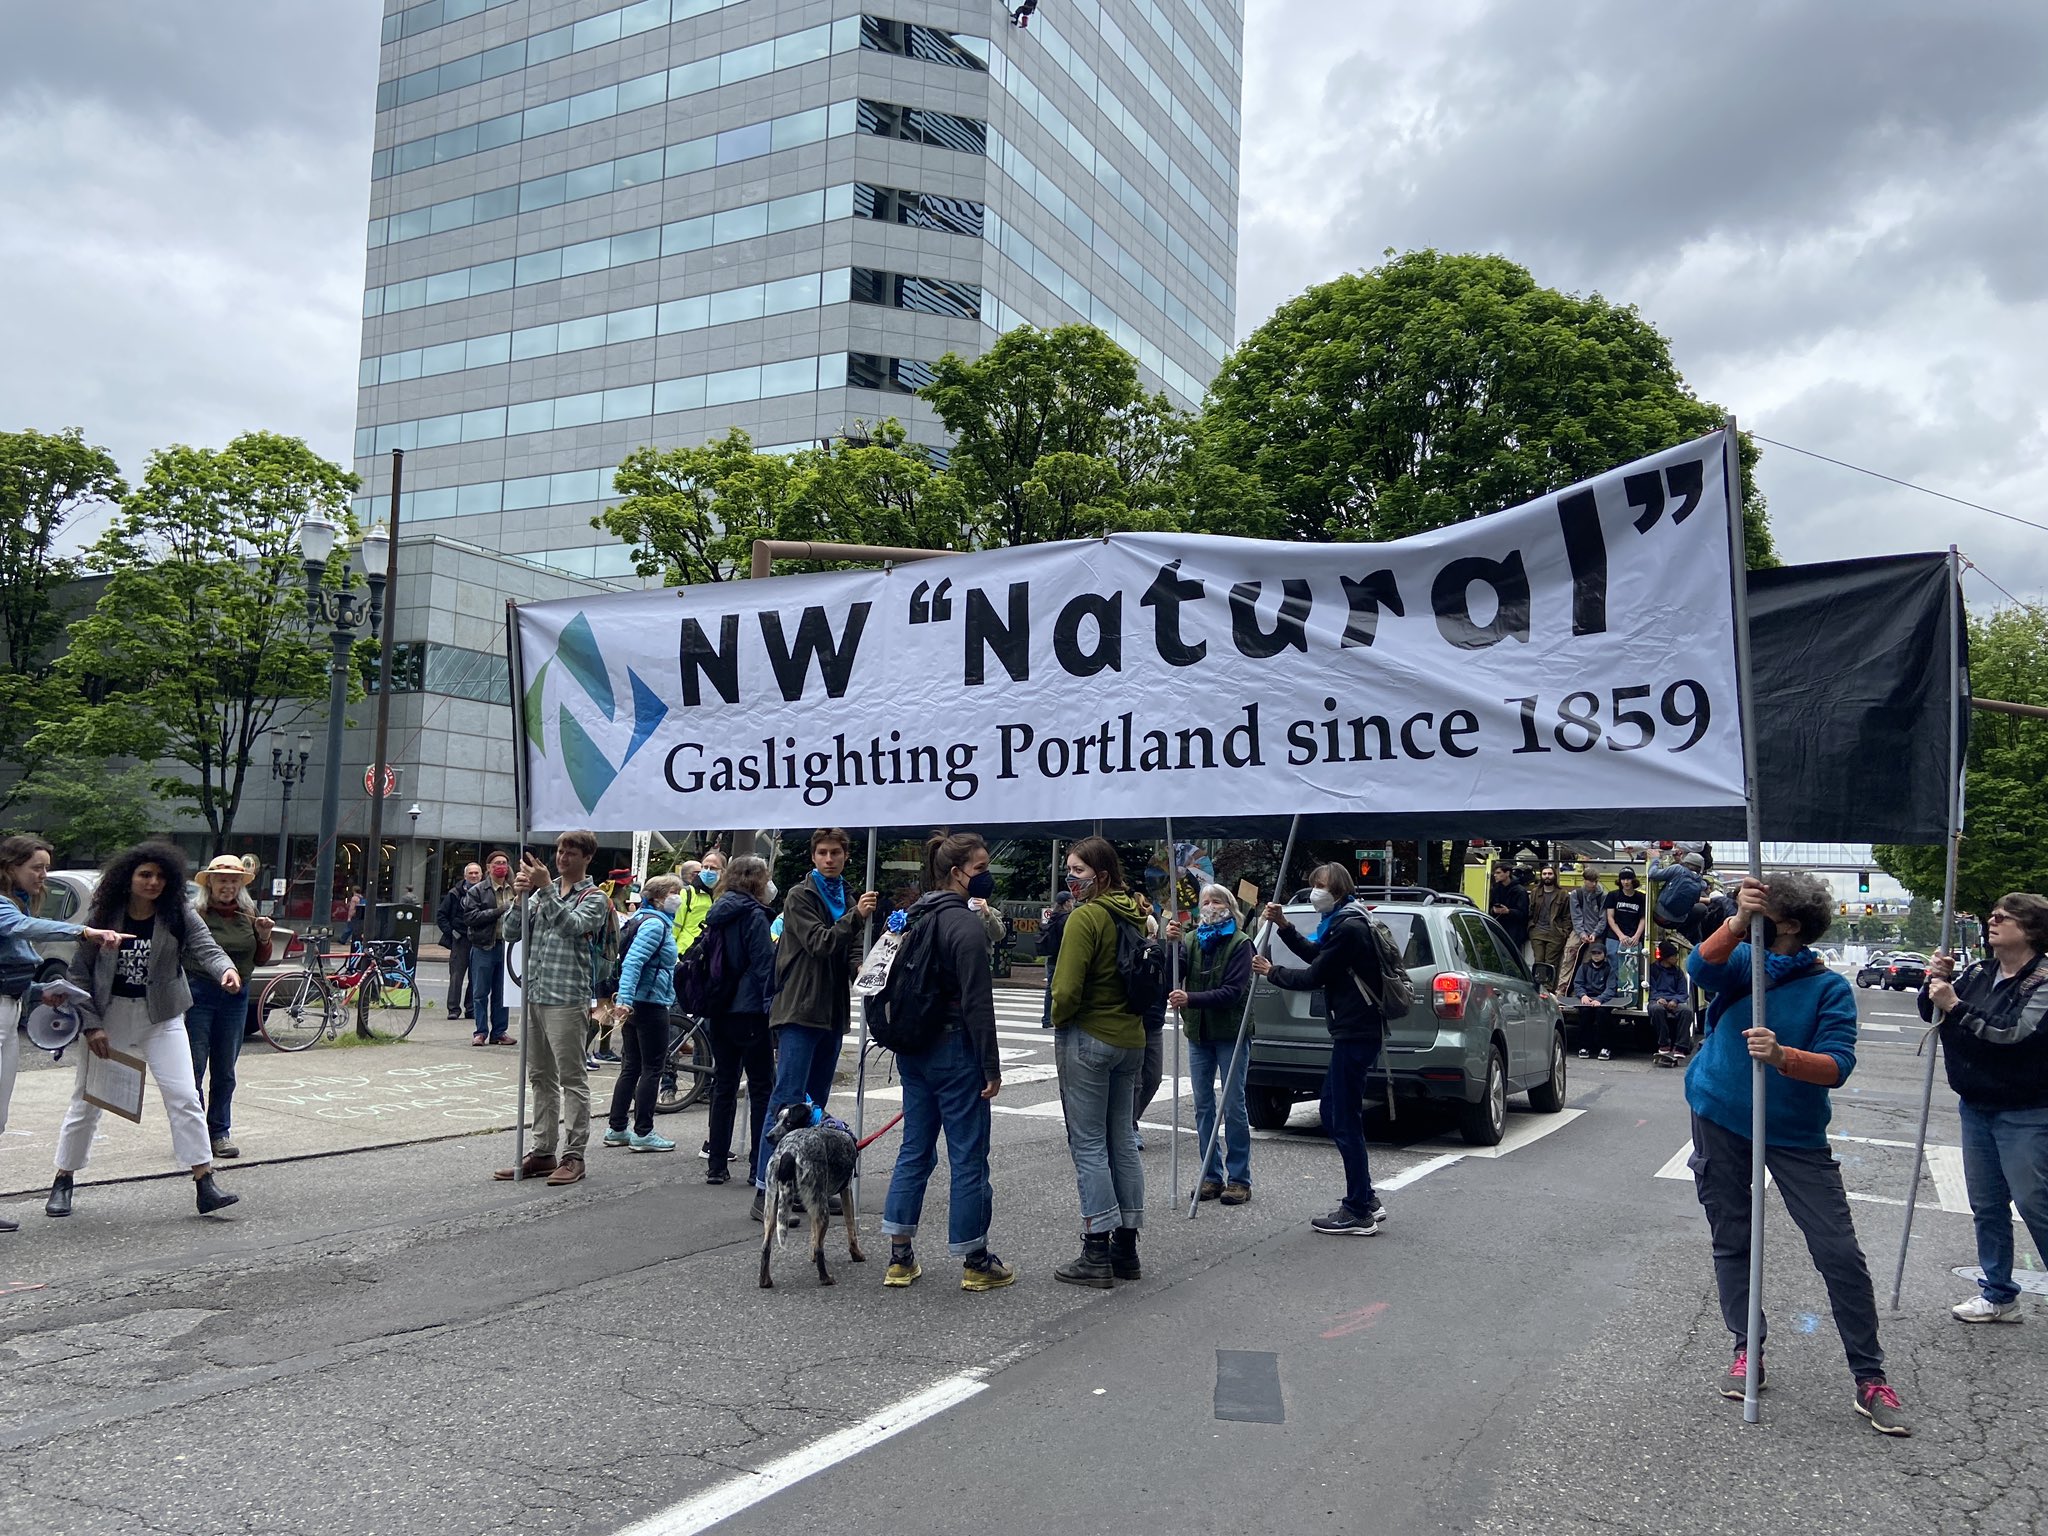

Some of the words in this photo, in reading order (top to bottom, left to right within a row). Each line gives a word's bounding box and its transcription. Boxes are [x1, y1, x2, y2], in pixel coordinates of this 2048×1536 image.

[679, 602, 872, 706] NW
[908, 459, 1704, 687] “Natural”
[664, 730, 979, 807] Gaslighting
[996, 701, 1266, 780] Portland
[1286, 697, 1480, 766] since
[1505, 679, 1711, 754] 1859
